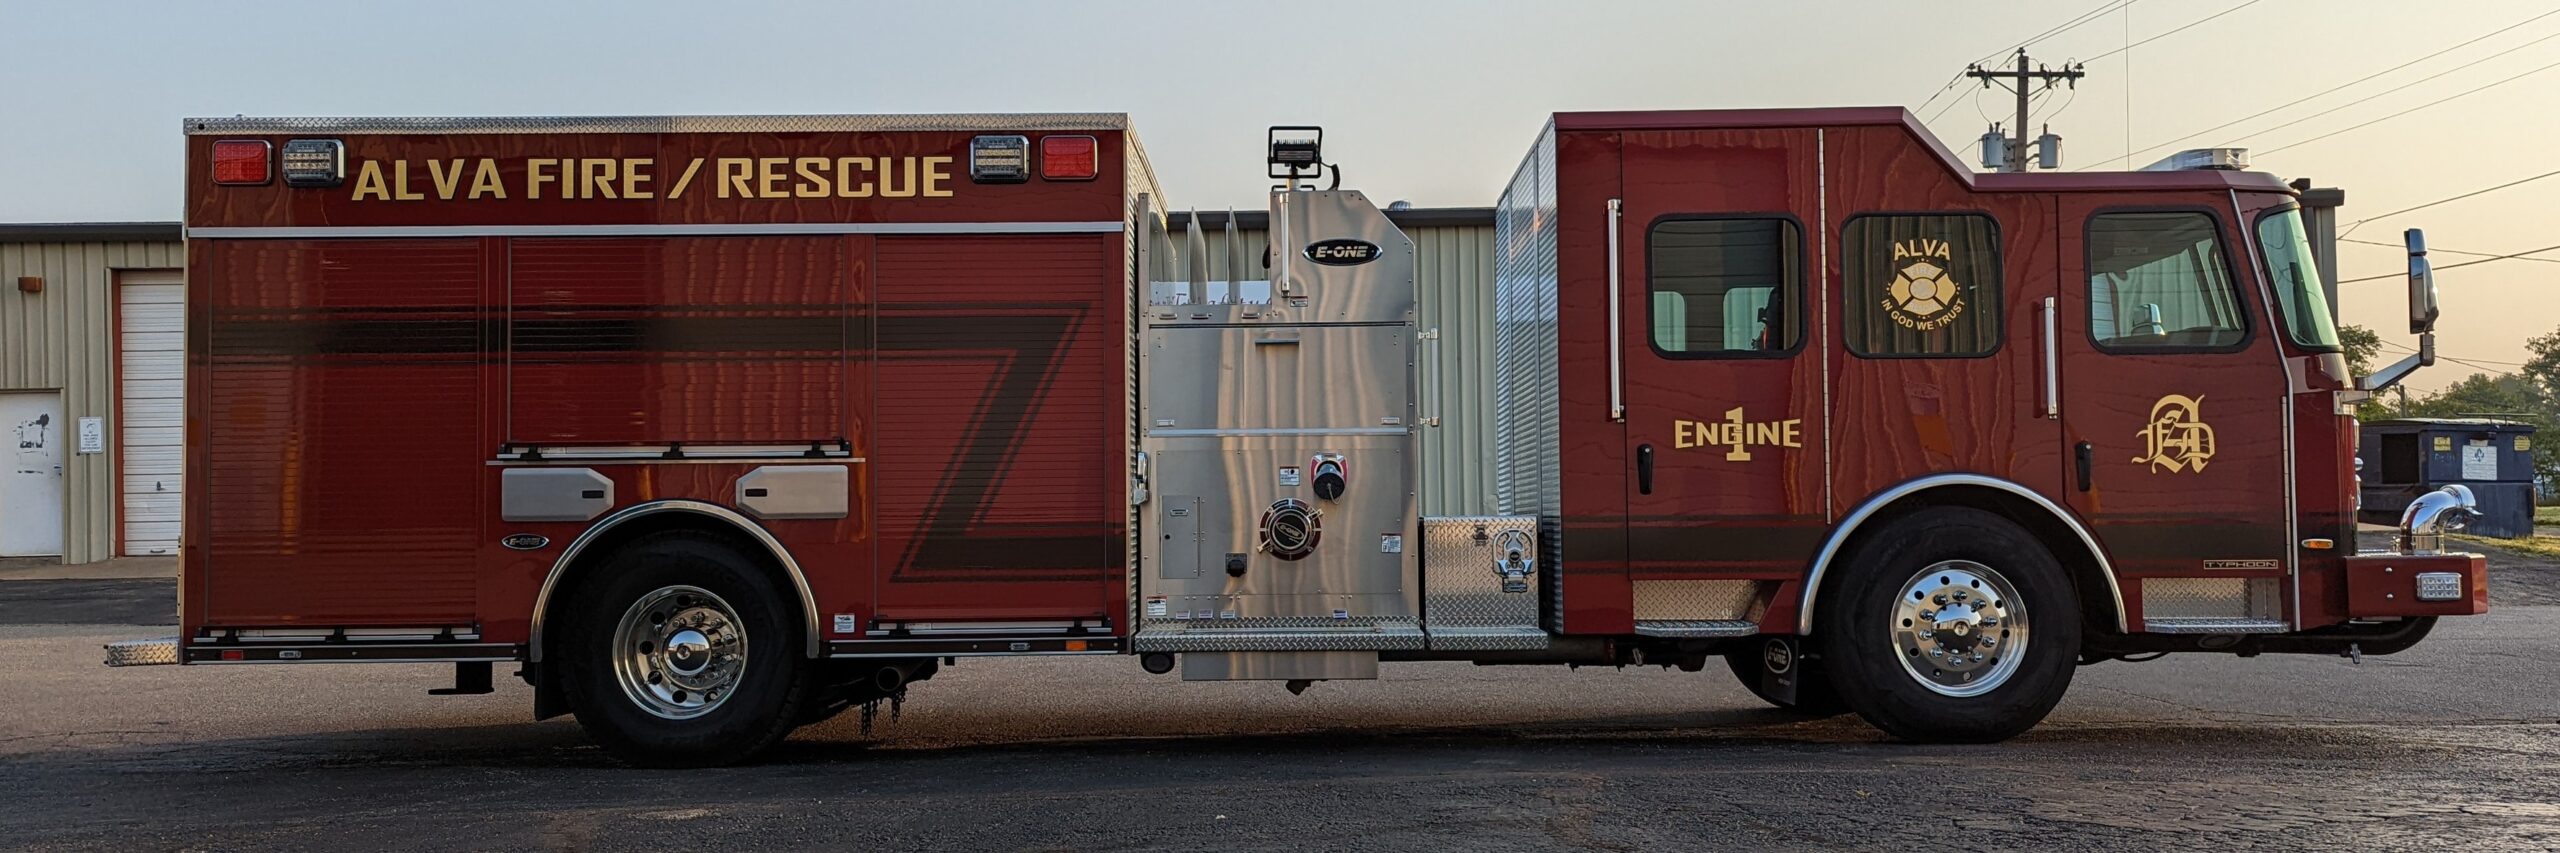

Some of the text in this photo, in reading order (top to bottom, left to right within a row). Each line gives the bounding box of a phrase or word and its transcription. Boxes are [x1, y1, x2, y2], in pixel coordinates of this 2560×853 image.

[351, 158, 508, 201] ALVA
[527, 158, 655, 200] FIRE
[717, 156, 954, 199] RESCUE
[1315, 245, 1369, 258] E-ONE
[1894, 238, 1951, 261] ALVA
[1881, 299, 1893, 312] IN
[1890, 310, 1914, 328] GOD
[1916, 321, 1935, 331] WE
[1935, 298, 1966, 327] TRUST
[1675, 418, 1802, 449] ENGINE
